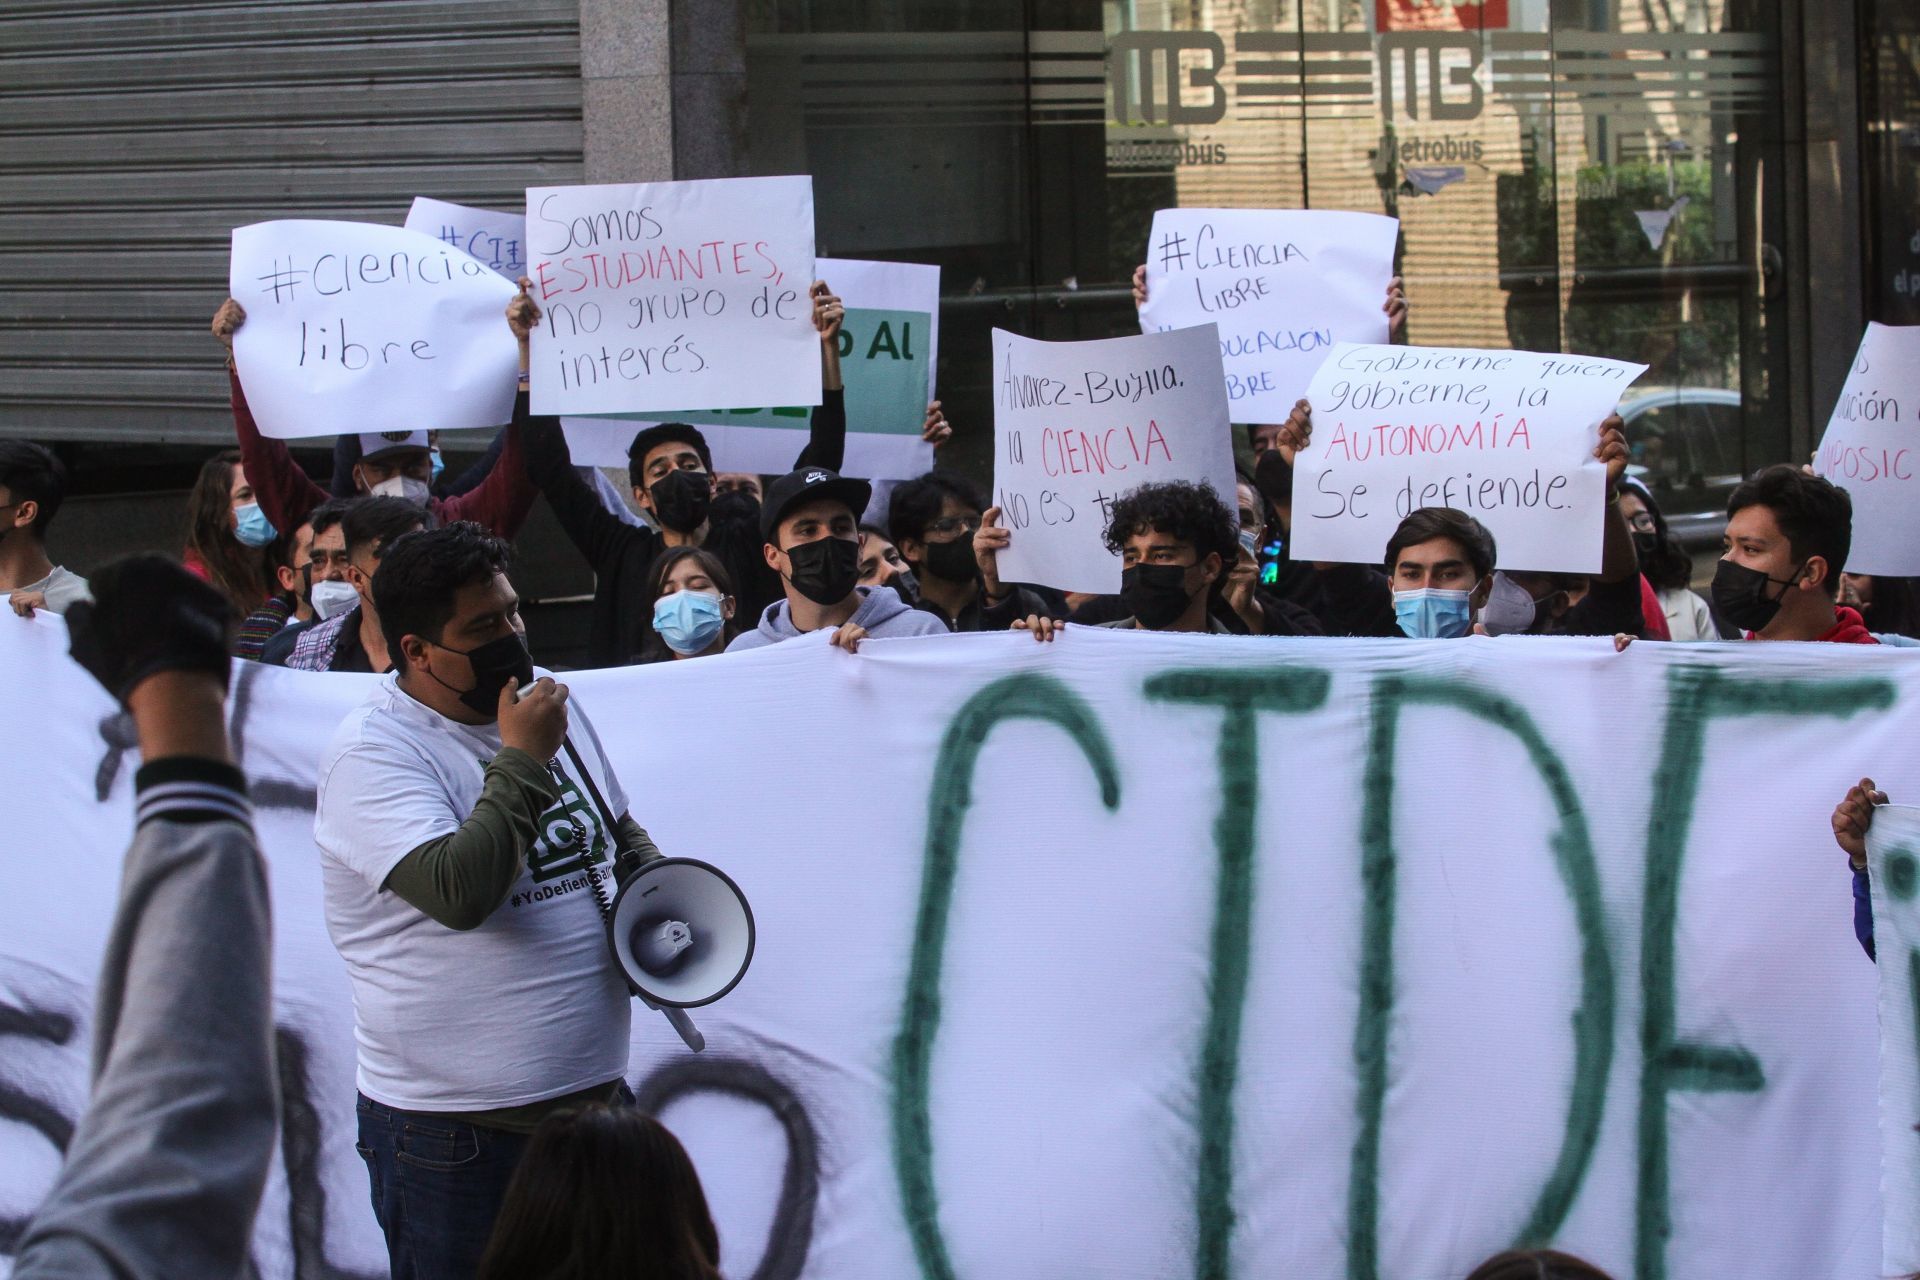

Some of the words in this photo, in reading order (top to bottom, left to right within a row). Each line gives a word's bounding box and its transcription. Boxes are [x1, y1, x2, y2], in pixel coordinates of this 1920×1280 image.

[1400, 133, 1484, 161] etrobús
[540, 194, 663, 255] Somos
[537, 240, 785, 300] ESTUDIANTES,
[1196, 276, 1271, 313] LIBRE
[547, 300, 601, 338] no
[629, 286, 726, 330] grupo
[752, 286, 798, 321] de
[300, 318, 436, 370] libre
[560, 334, 710, 390] interés.
[1337, 346, 1513, 374] Gobierne
[1541, 359, 1626, 379] quien
[1225, 370, 1277, 400] BRE
[1321, 379, 1491, 415] gobierne,
[1517, 386, 1549, 407] la
[1008, 430, 1024, 465] la
[1042, 419, 1172, 477] CIENCIA
[1324, 412, 1531, 462] AUTONOMÍA
[1312, 469, 1369, 519] Se
[1396, 468, 1573, 518] defiende.
